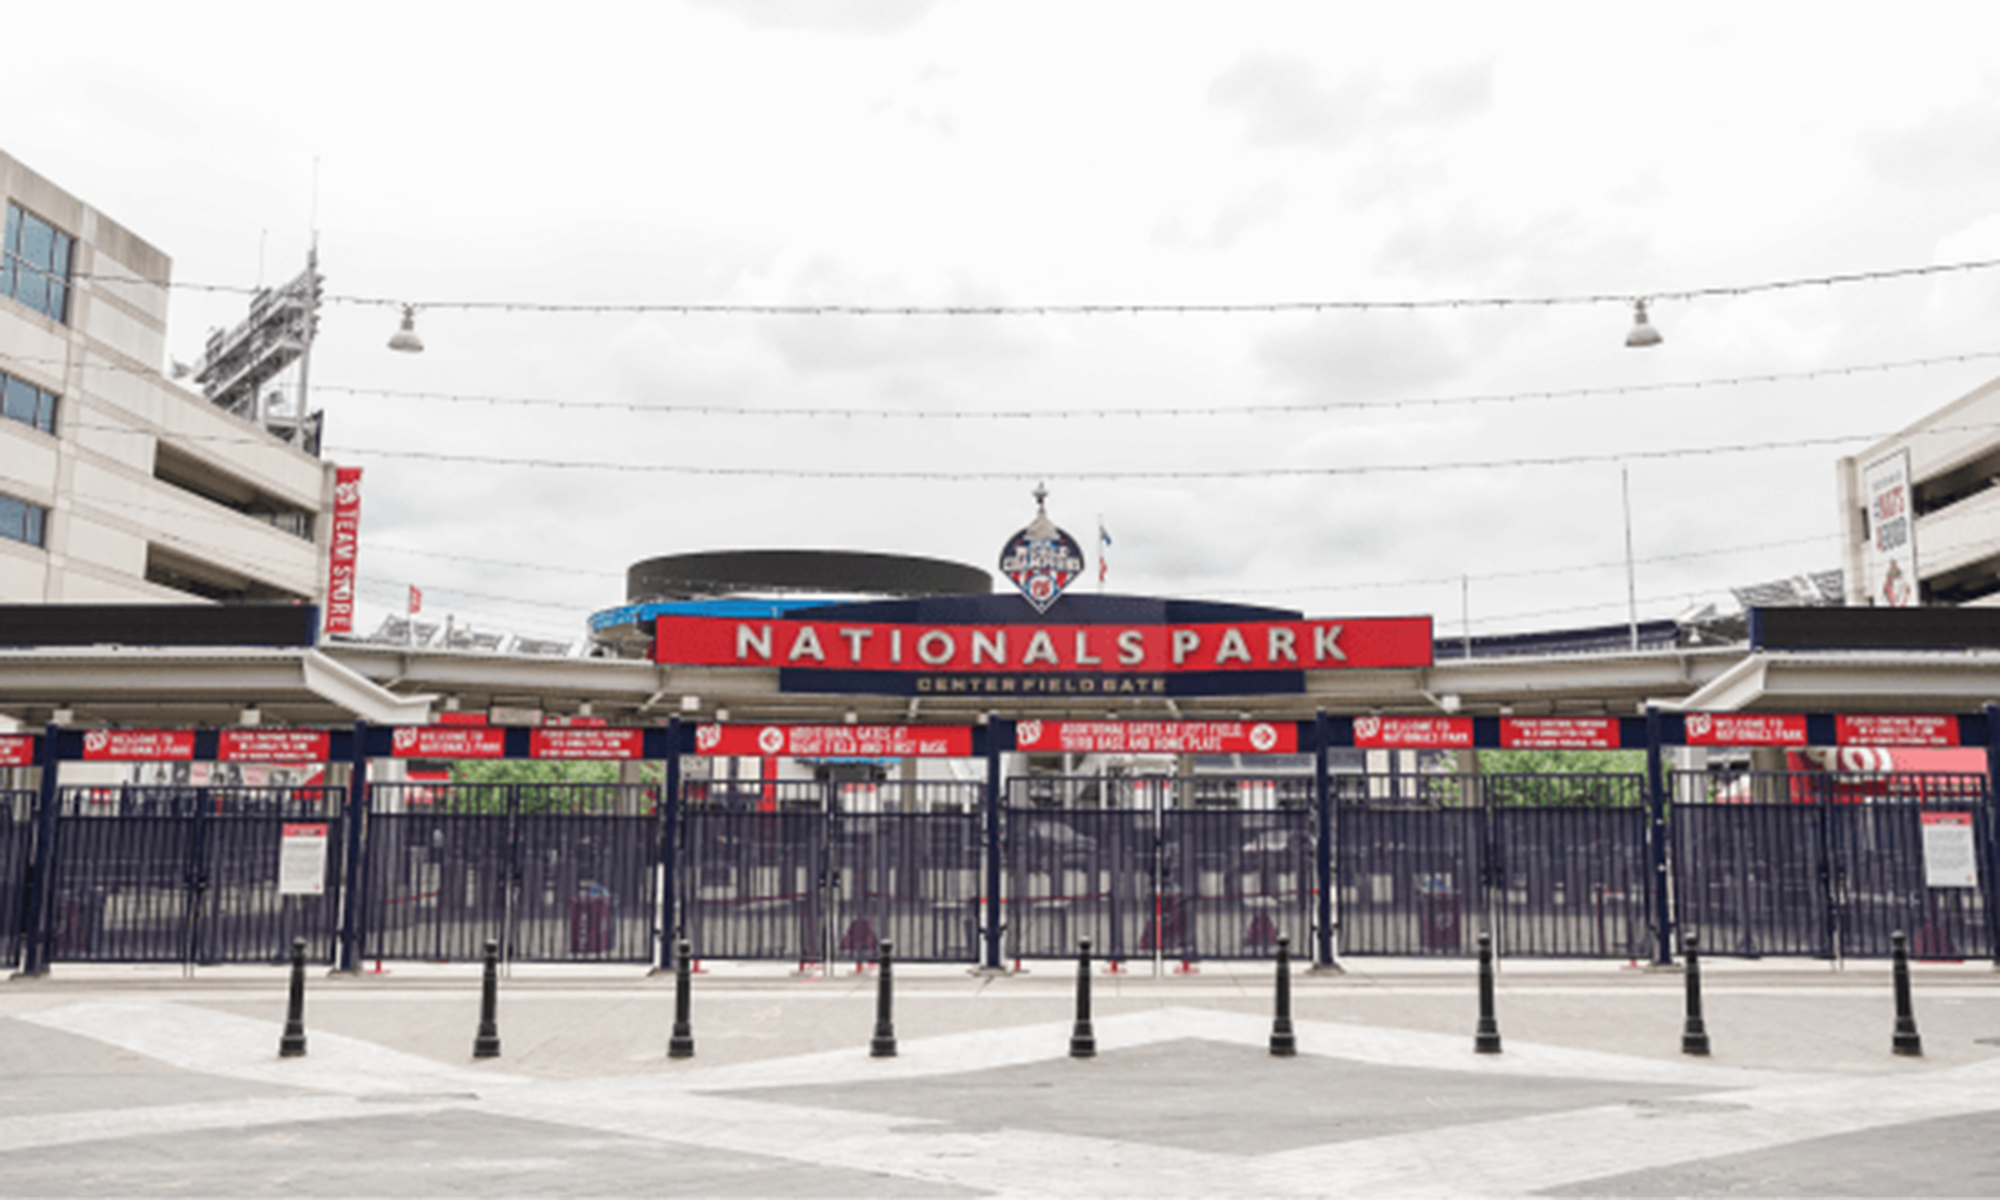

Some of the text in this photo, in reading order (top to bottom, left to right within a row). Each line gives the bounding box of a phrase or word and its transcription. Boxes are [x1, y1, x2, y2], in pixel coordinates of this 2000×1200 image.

[329, 510, 357, 627] TEAM STORE
[736, 623, 1347, 665] NATIONALS PARK
[916, 677, 1168, 692] CENTER FIELD GATE
